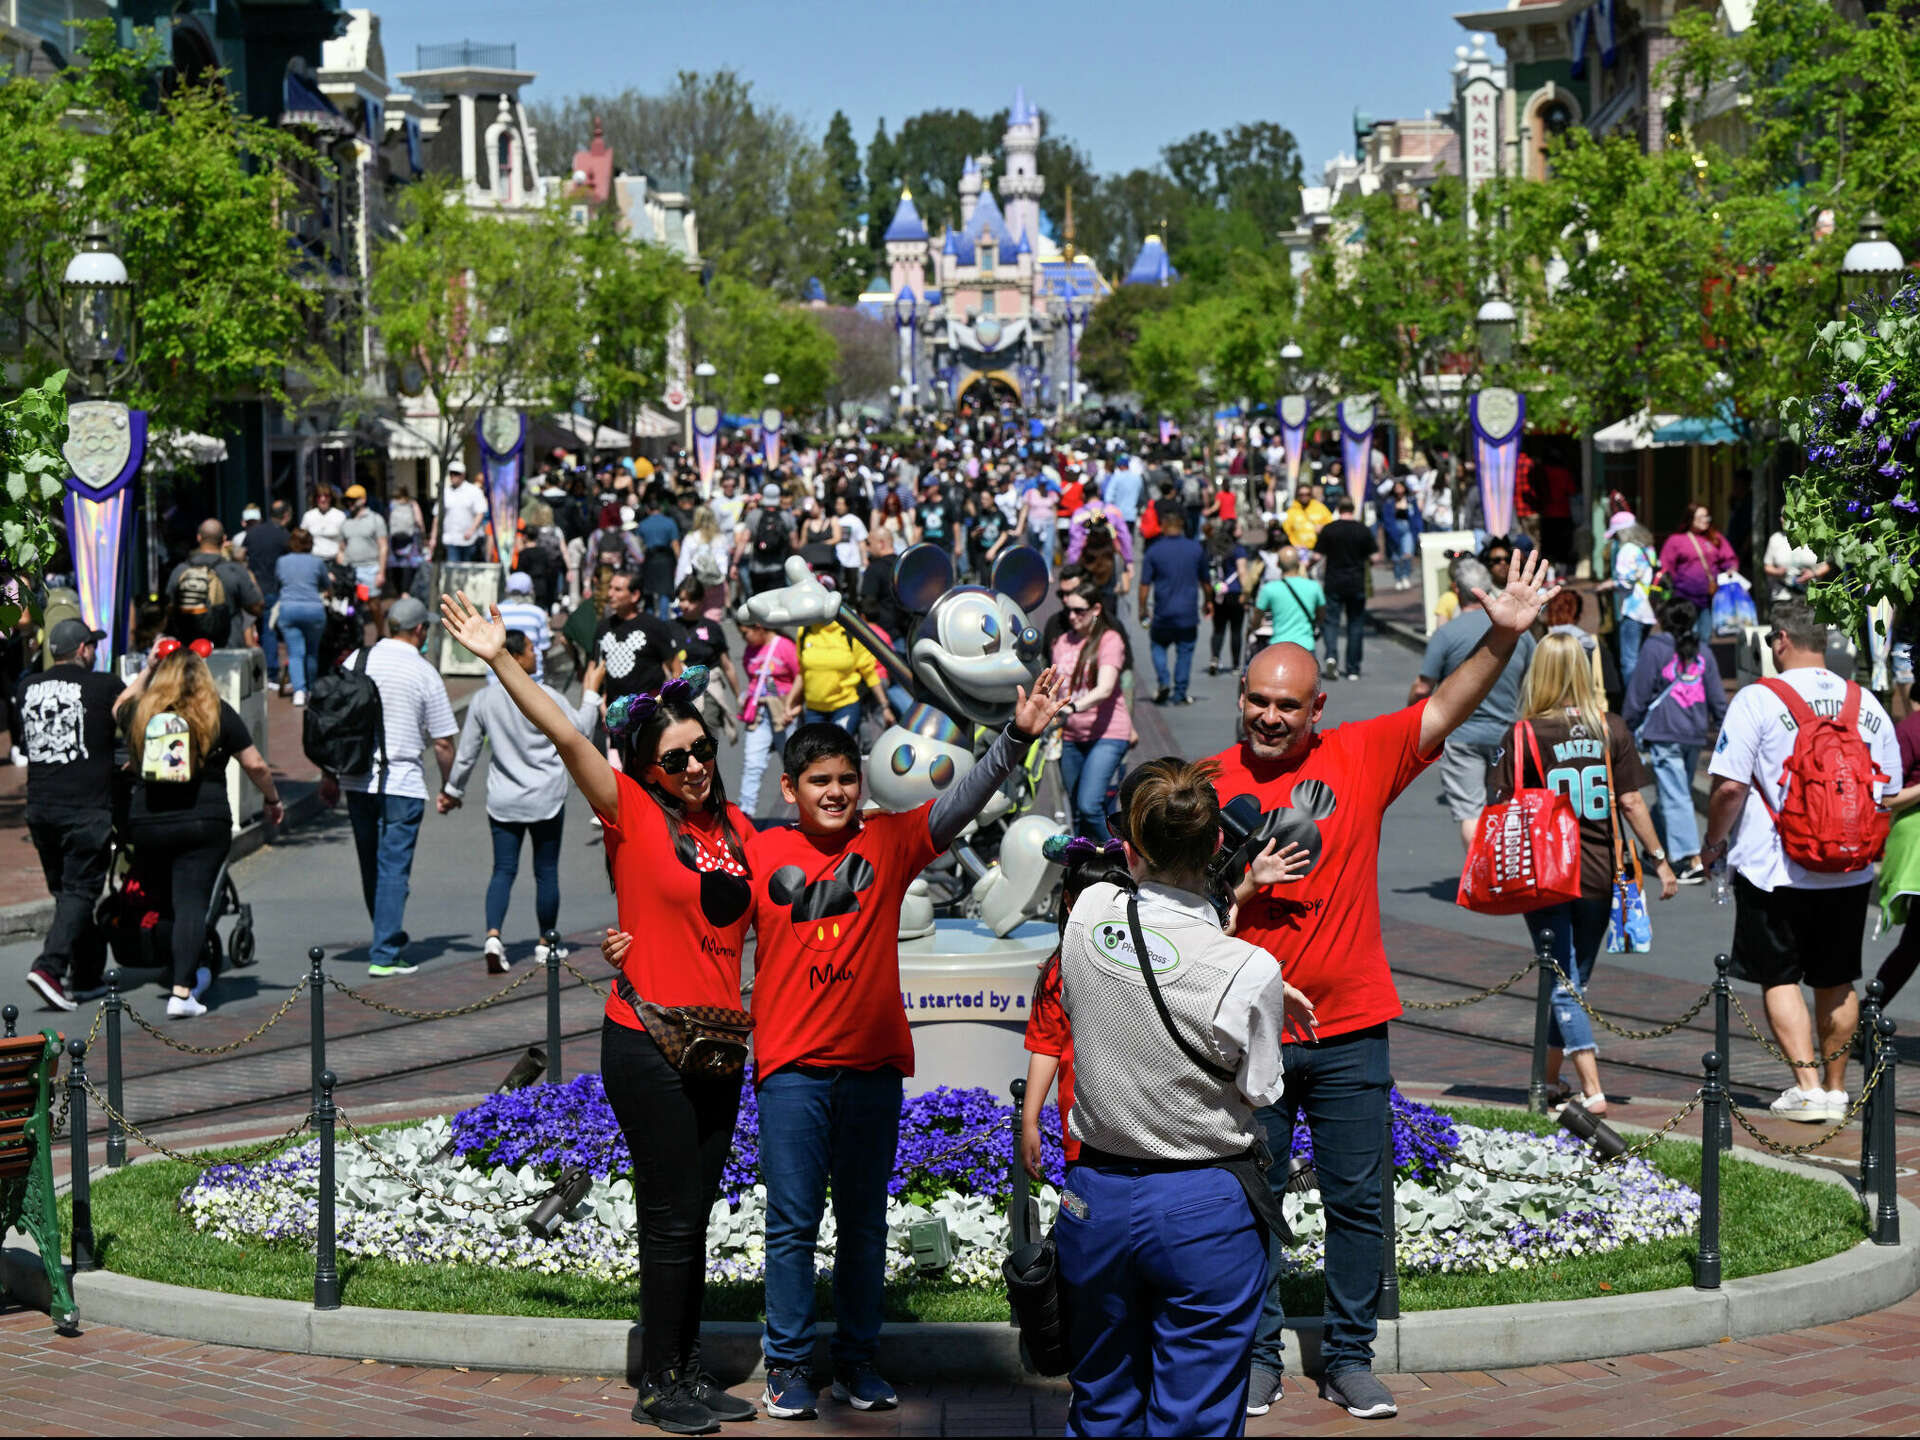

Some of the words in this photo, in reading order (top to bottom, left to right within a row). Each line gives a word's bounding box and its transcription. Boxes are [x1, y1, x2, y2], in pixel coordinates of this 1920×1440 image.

[1547, 765, 1609, 820] 06
[900, 991, 914, 1009] ll
[919, 990, 984, 1009] started
[990, 990, 1010, 1012] by
[1015, 995, 1026, 1009] a
